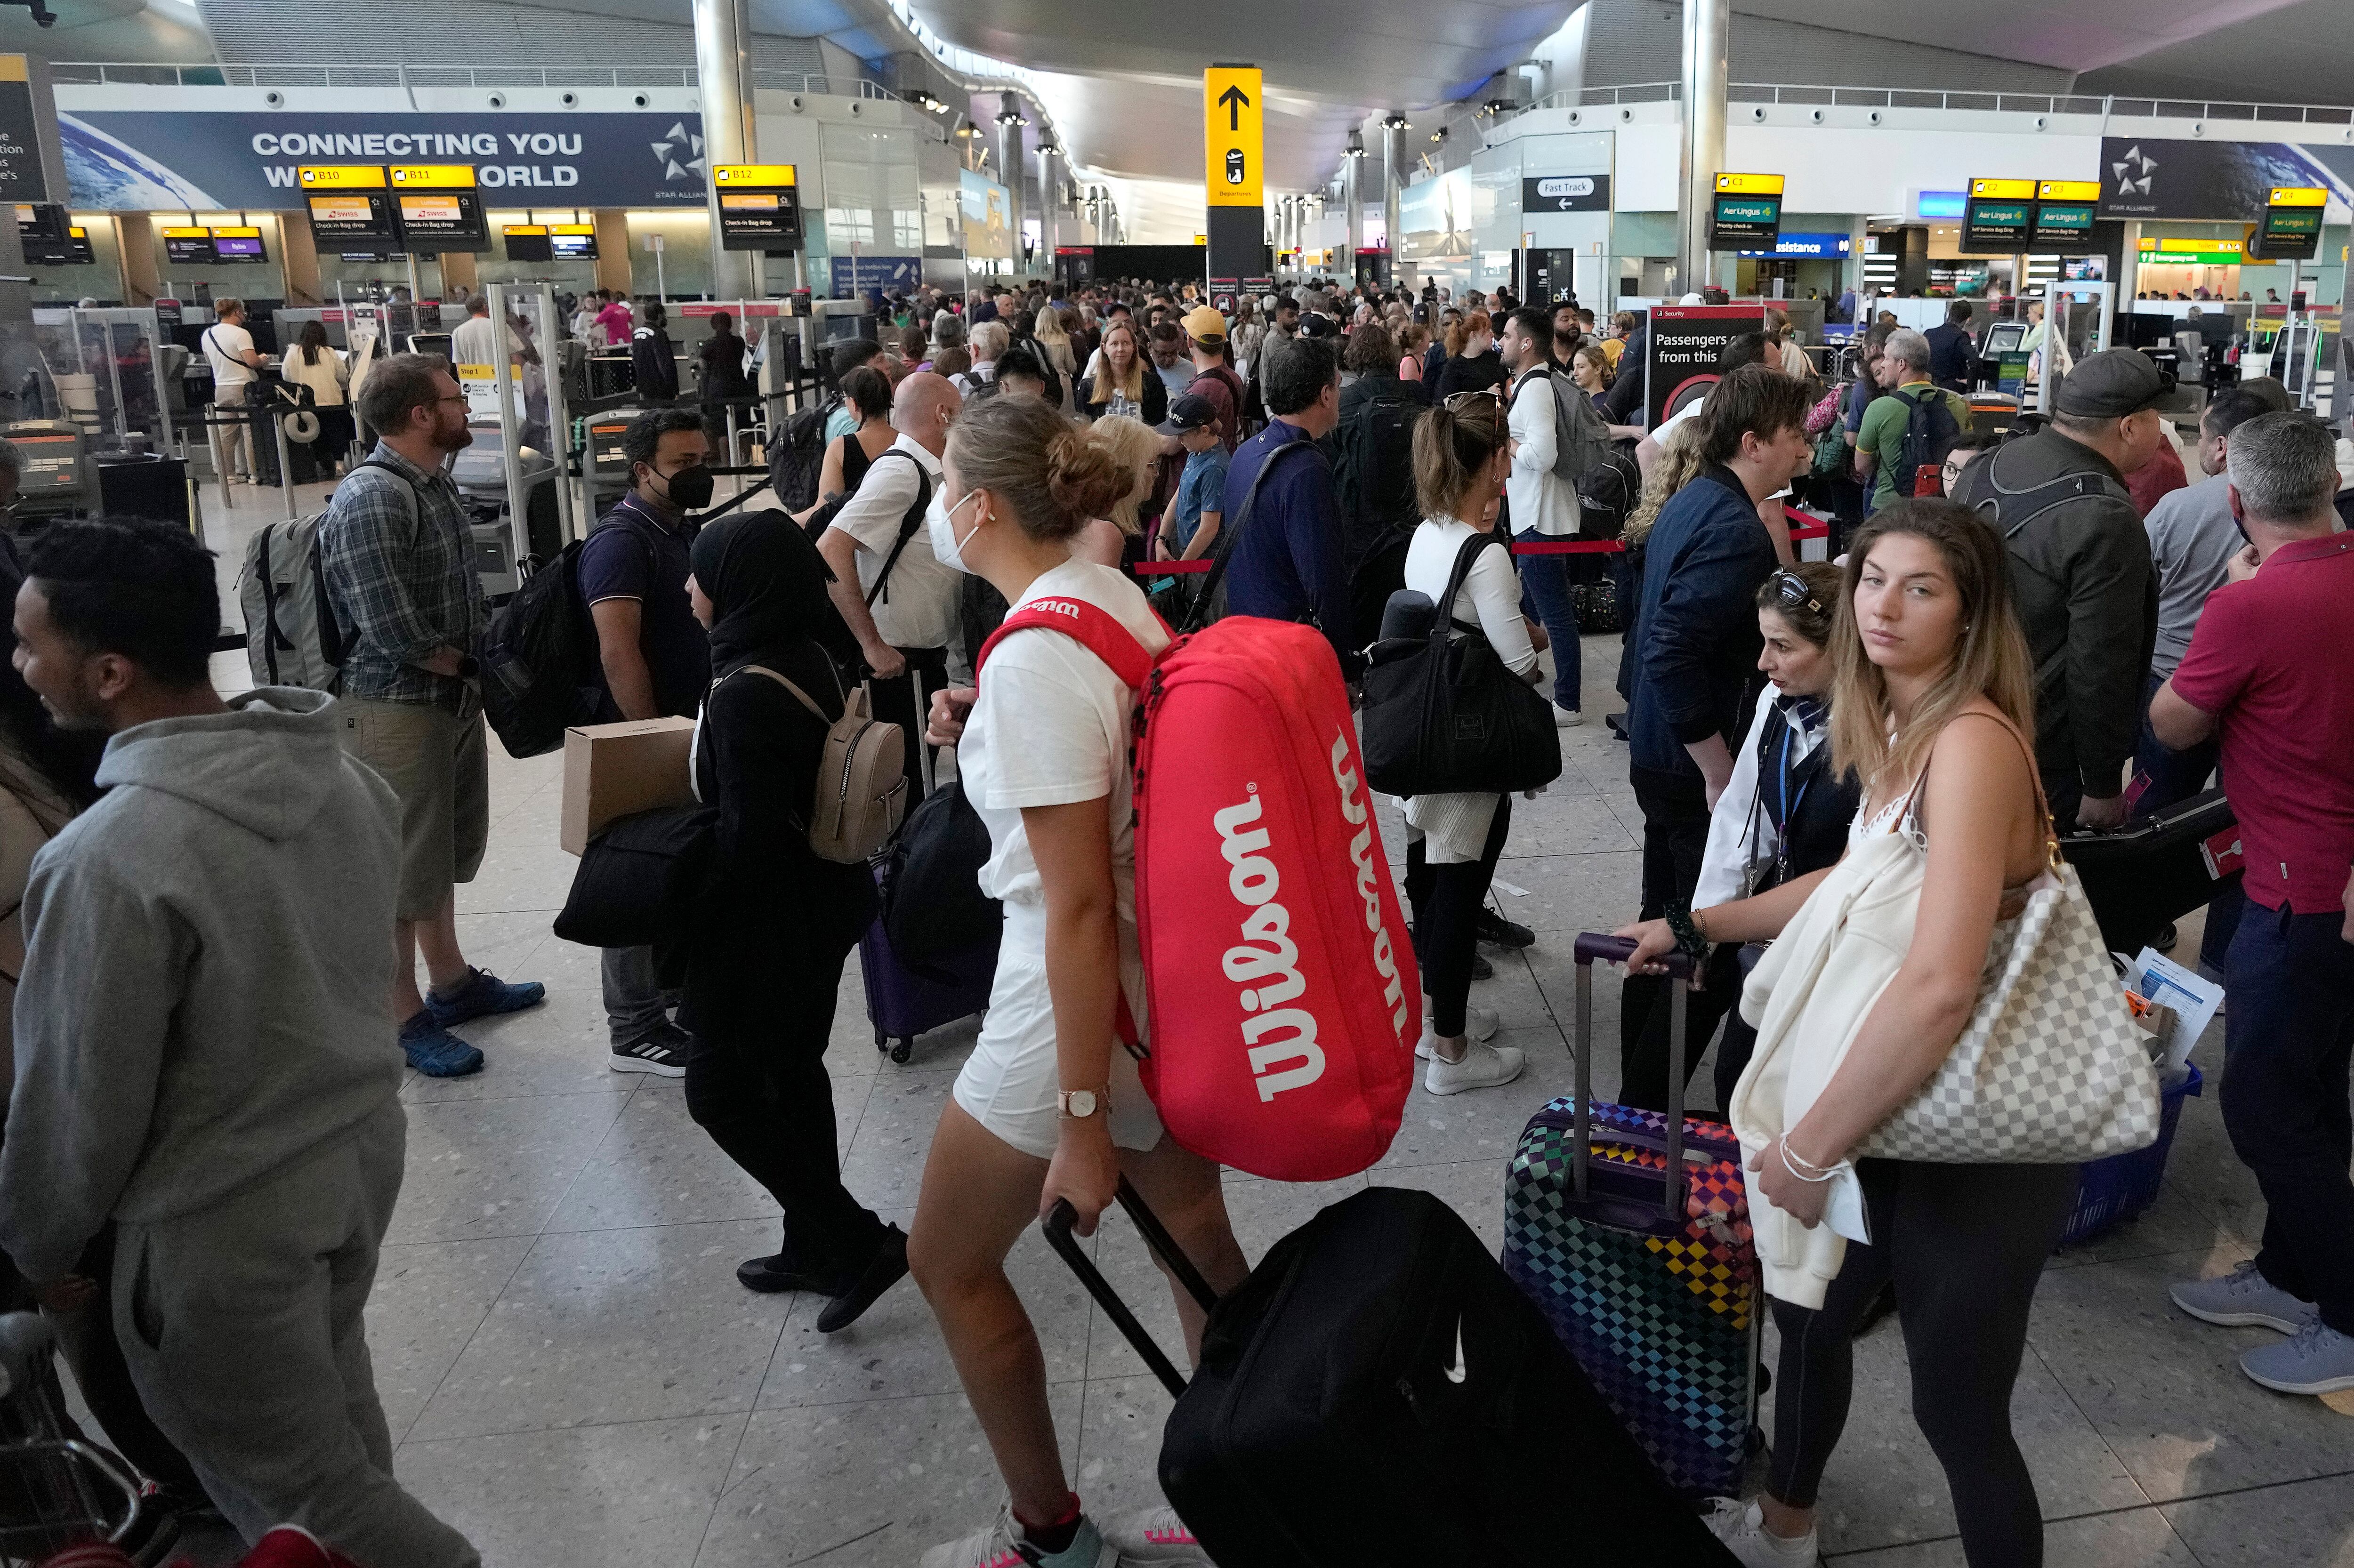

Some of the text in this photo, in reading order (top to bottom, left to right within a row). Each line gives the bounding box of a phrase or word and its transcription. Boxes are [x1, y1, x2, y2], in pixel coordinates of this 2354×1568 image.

[0, 144, 24, 154] tion
[252, 133, 582, 156] CONNECTING YOU
[0, 170, 18, 180] e's
[319, 171, 339, 179] B10
[410, 171, 430, 179] B11
[479, 165, 579, 188] ORLD
[733, 170, 752, 178] B12
[1545, 182, 1587, 192] Fast Track
[1737, 207, 1761, 217] Lingus
[1991, 212, 2013, 221] Lingus
[2056, 214, 2077, 223] Lingus
[2285, 219, 2305, 228] Lingus
[1775, 241, 1821, 254] ssistance
[2155, 254, 2186, 263] Emergency
[1656, 334, 1727, 348] Passengers
[1659, 350, 1717, 363] from this
[1013, 600, 1080, 619] Wilso
[1331, 724, 1408, 1039] Wilson
[1213, 794, 1326, 1102] Wilson
